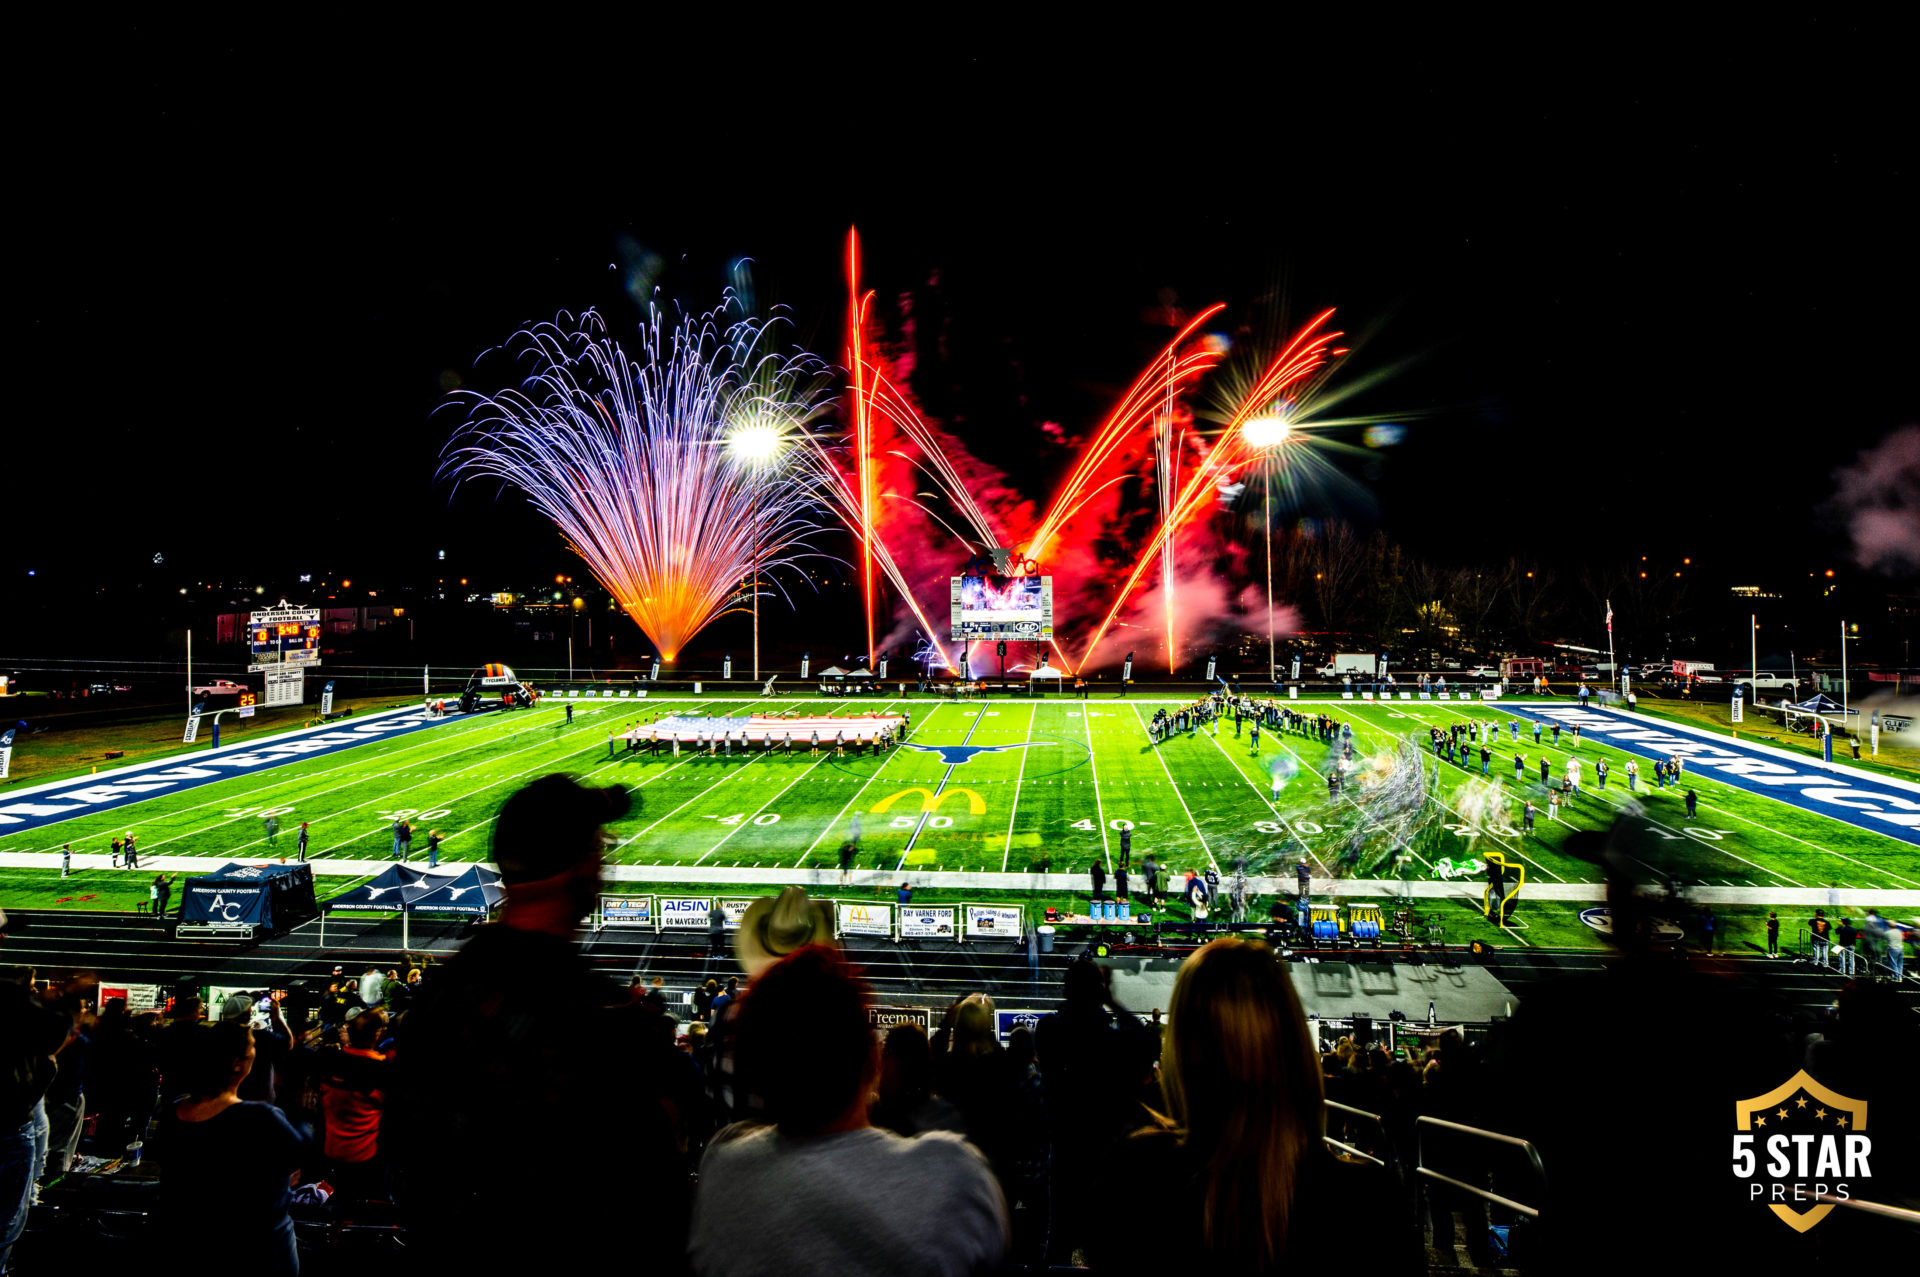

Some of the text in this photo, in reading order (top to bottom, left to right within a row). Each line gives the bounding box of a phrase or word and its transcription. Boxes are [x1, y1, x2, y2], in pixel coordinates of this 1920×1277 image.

[240, 693, 256, 706] 25
[716, 813, 780, 826] 40
[888, 816, 955, 829] 50
[1070, 818, 1135, 831] 40
[1254, 821, 1323, 834] 30
[1443, 823, 1520, 838] 20
[1645, 826, 1724, 840] 10
[208, 894, 241, 921] AC
[664, 901, 709, 911] AISIN
[938, 910, 952, 918] FORD
[868, 1008, 926, 1026] Freeman
